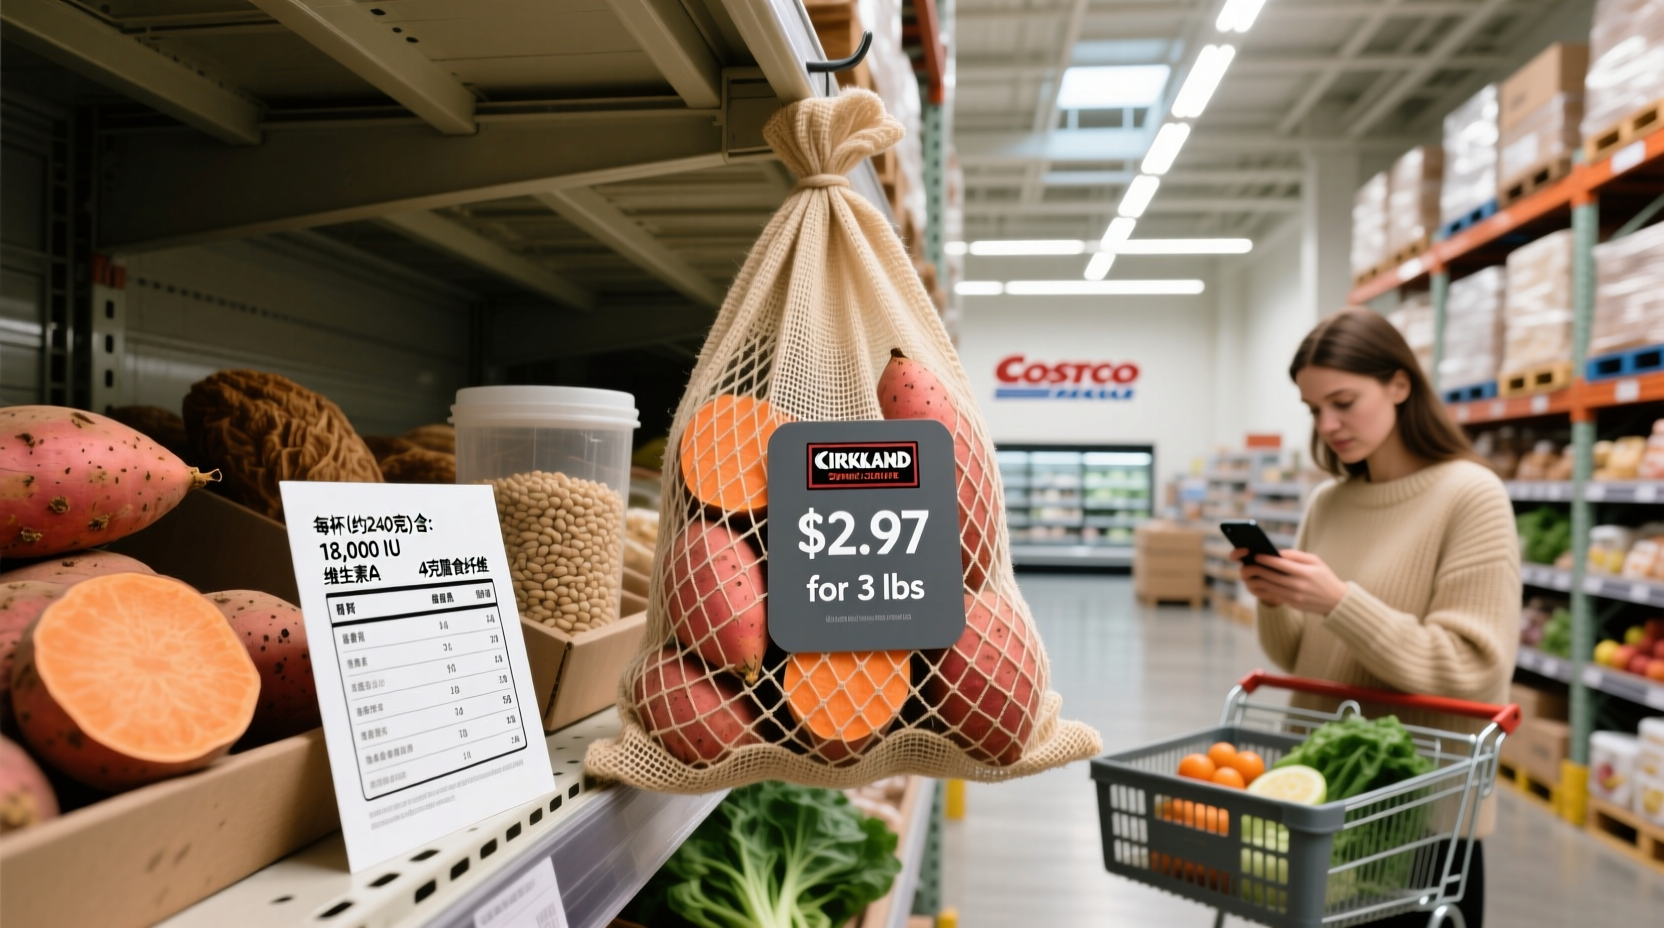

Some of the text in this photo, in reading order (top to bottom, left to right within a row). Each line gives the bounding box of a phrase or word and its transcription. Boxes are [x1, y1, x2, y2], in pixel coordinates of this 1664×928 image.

[797, 507, 930, 560] $2.97
[319, 539, 401, 563] 18,000 IU
[323, 565, 382, 586] 维生素A
[806, 572, 926, 602] for 3 lbs
